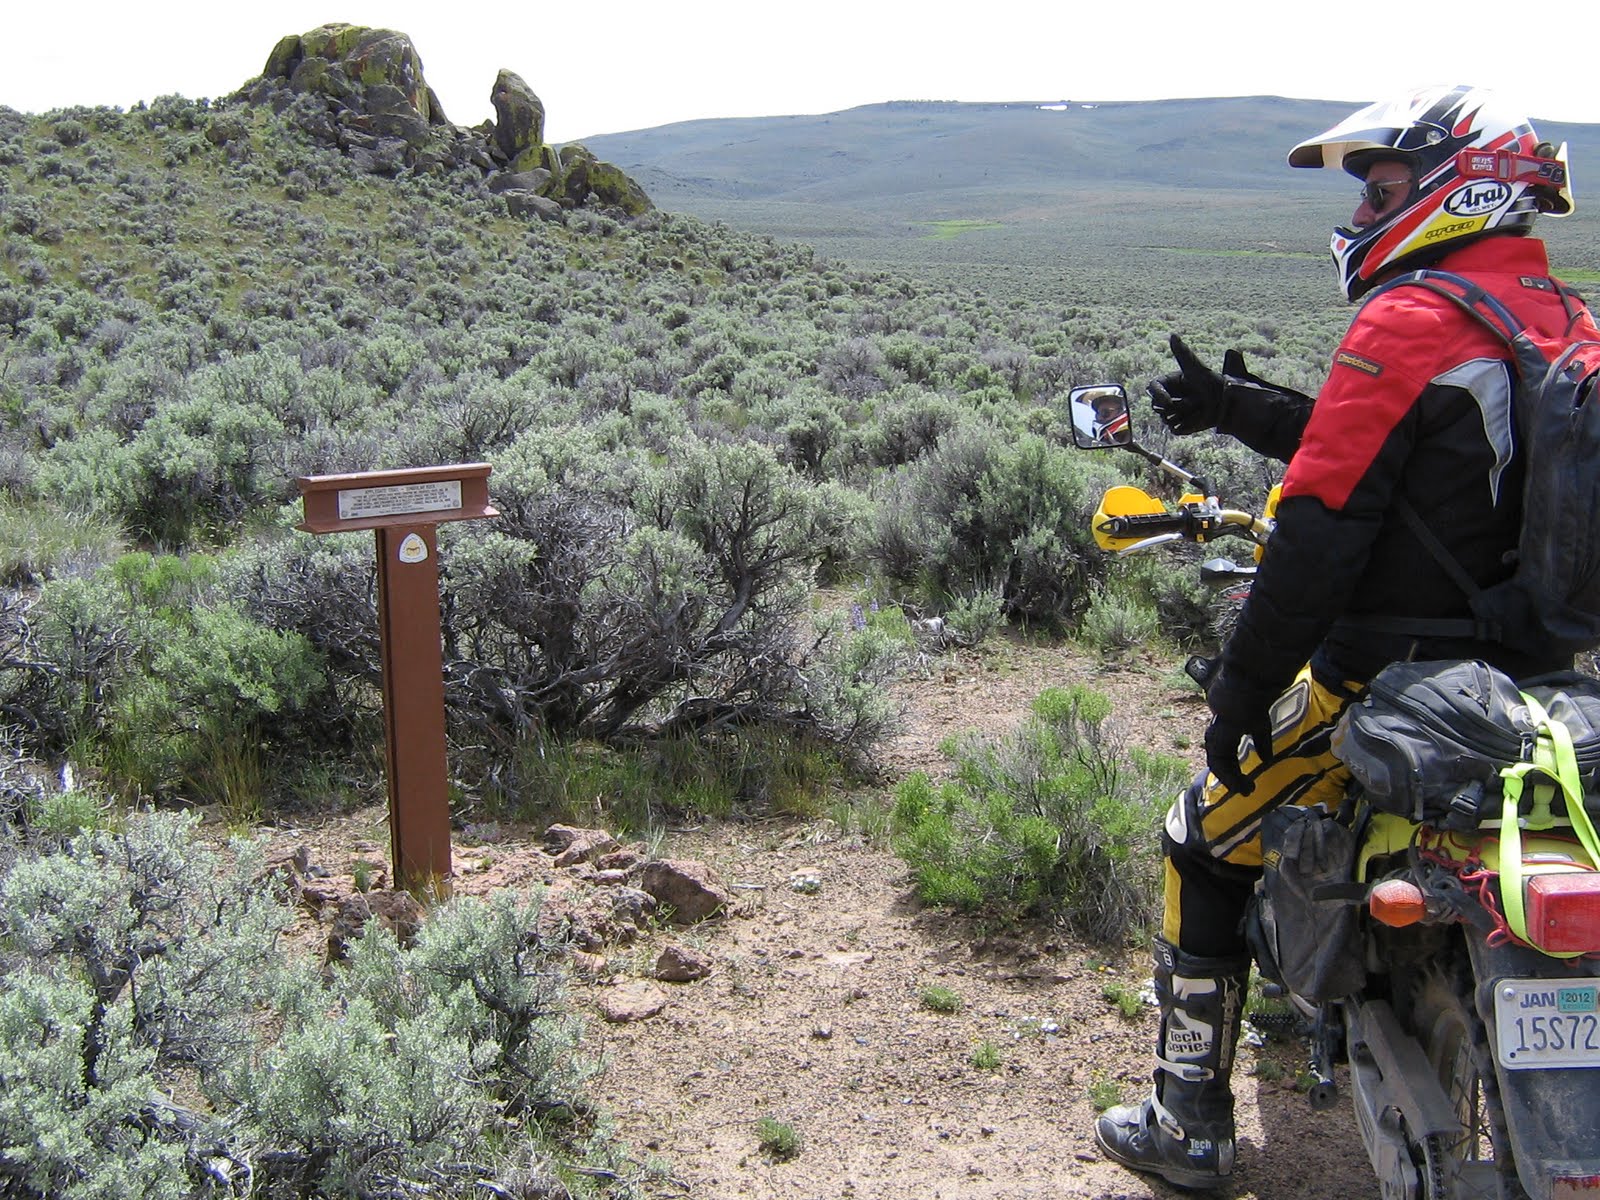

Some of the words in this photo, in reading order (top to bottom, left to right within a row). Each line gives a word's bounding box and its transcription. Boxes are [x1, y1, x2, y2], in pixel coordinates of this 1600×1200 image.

[1451, 183, 1505, 212] Arai
[1520, 992, 1555, 1008] JAN
[1565, 992, 1590, 1003] 2012
[1515, 1015, 1600, 1051] 15S72
[1189, 1138, 1212, 1150] Tech
